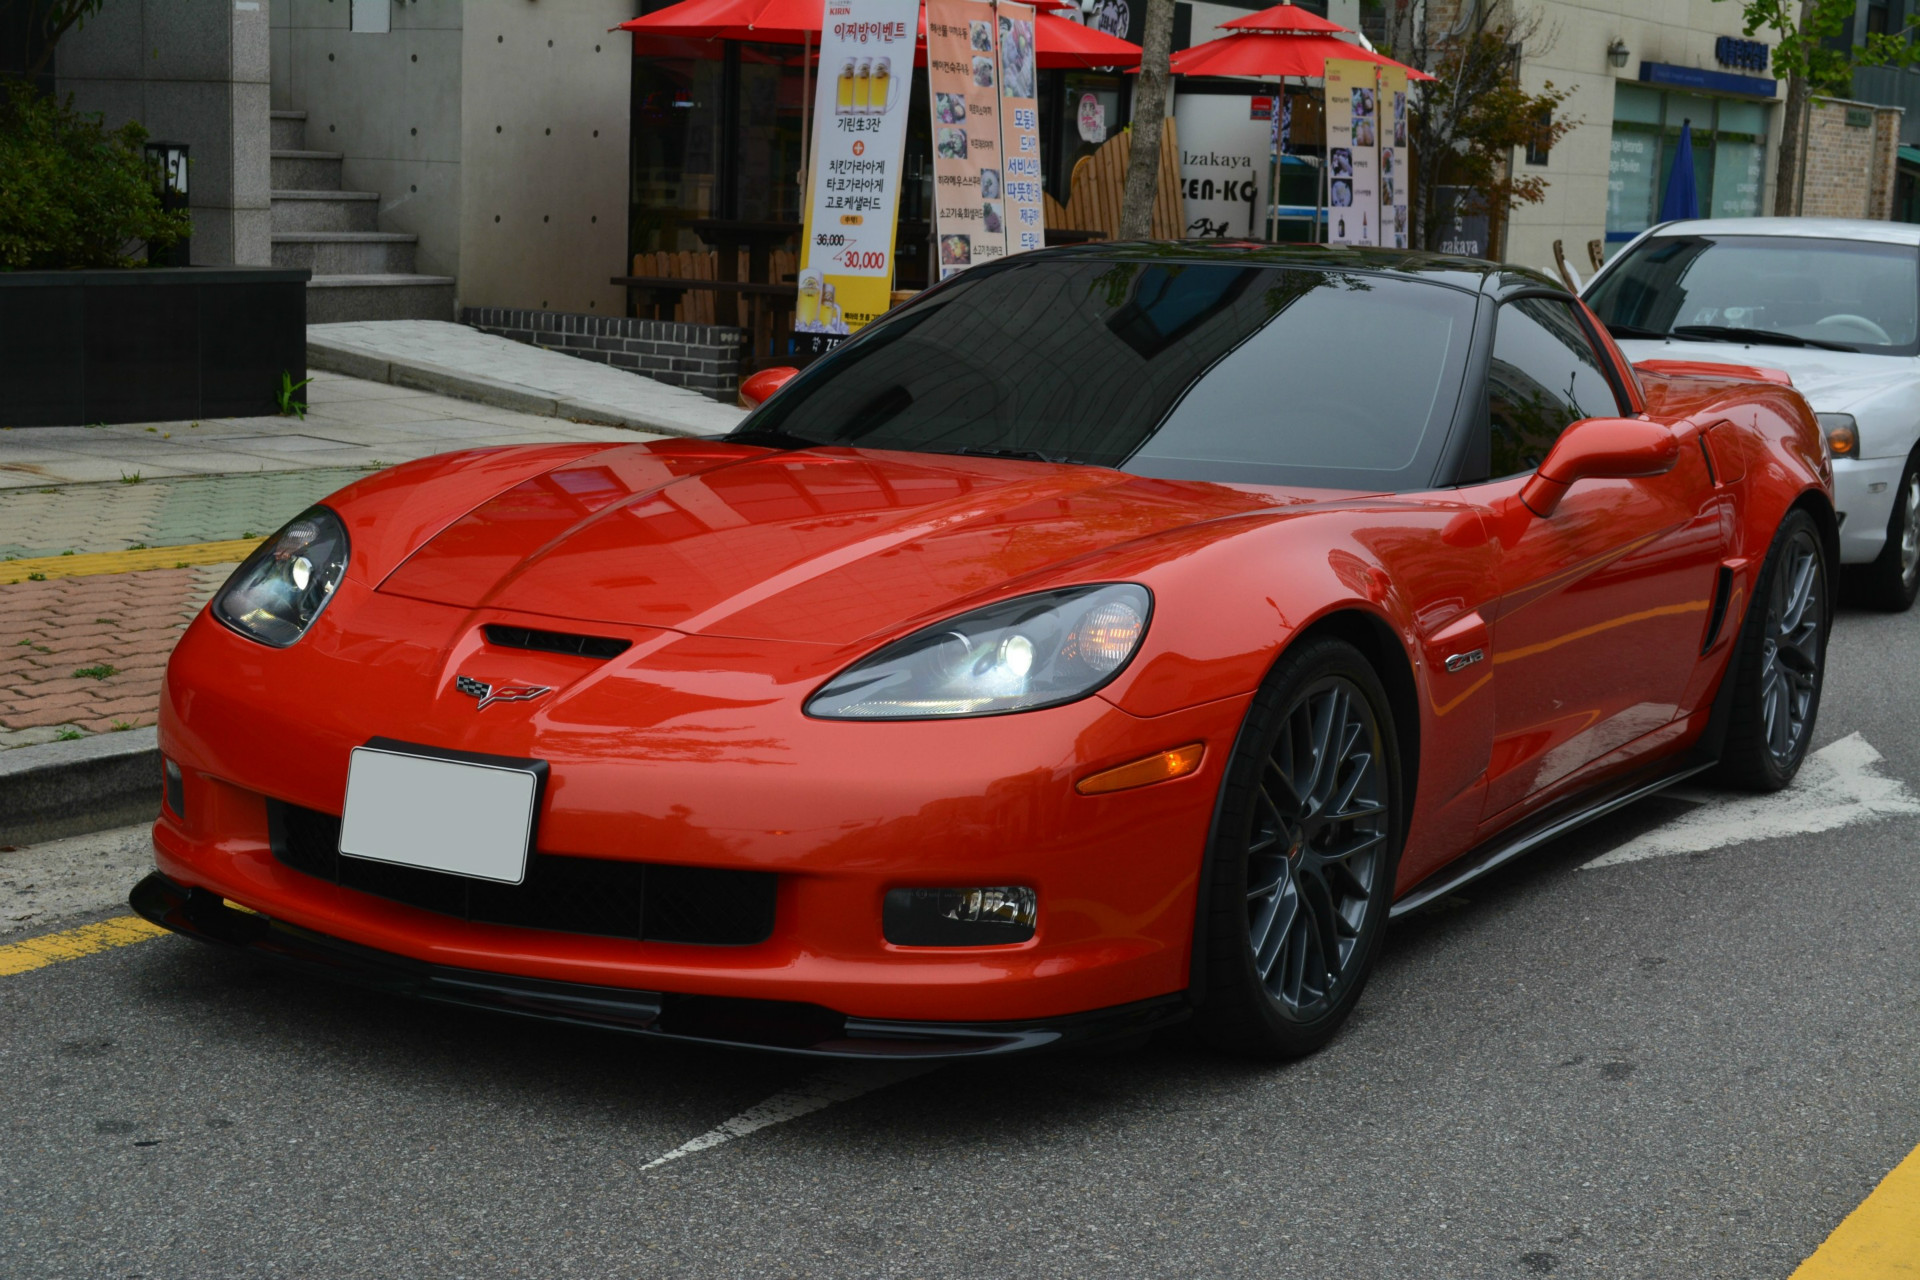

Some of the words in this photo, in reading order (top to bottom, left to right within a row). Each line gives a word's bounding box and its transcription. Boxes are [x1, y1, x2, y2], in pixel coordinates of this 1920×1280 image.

[829, 7, 851, 16] KIRIN
[834, 22, 906, 43] 이찌방이벤트
[829, 160, 885, 175] 치킨가라아게
[1183, 150, 1251, 169] Izakaya
[826, 178, 884, 193] 타코가라아게
[1007, 182, 1033, 202] 따뜻한
[816, 233, 845, 247] 36,000
[1441, 236, 1479, 257] zakaya
[844, 251, 885, 270] 30,000
